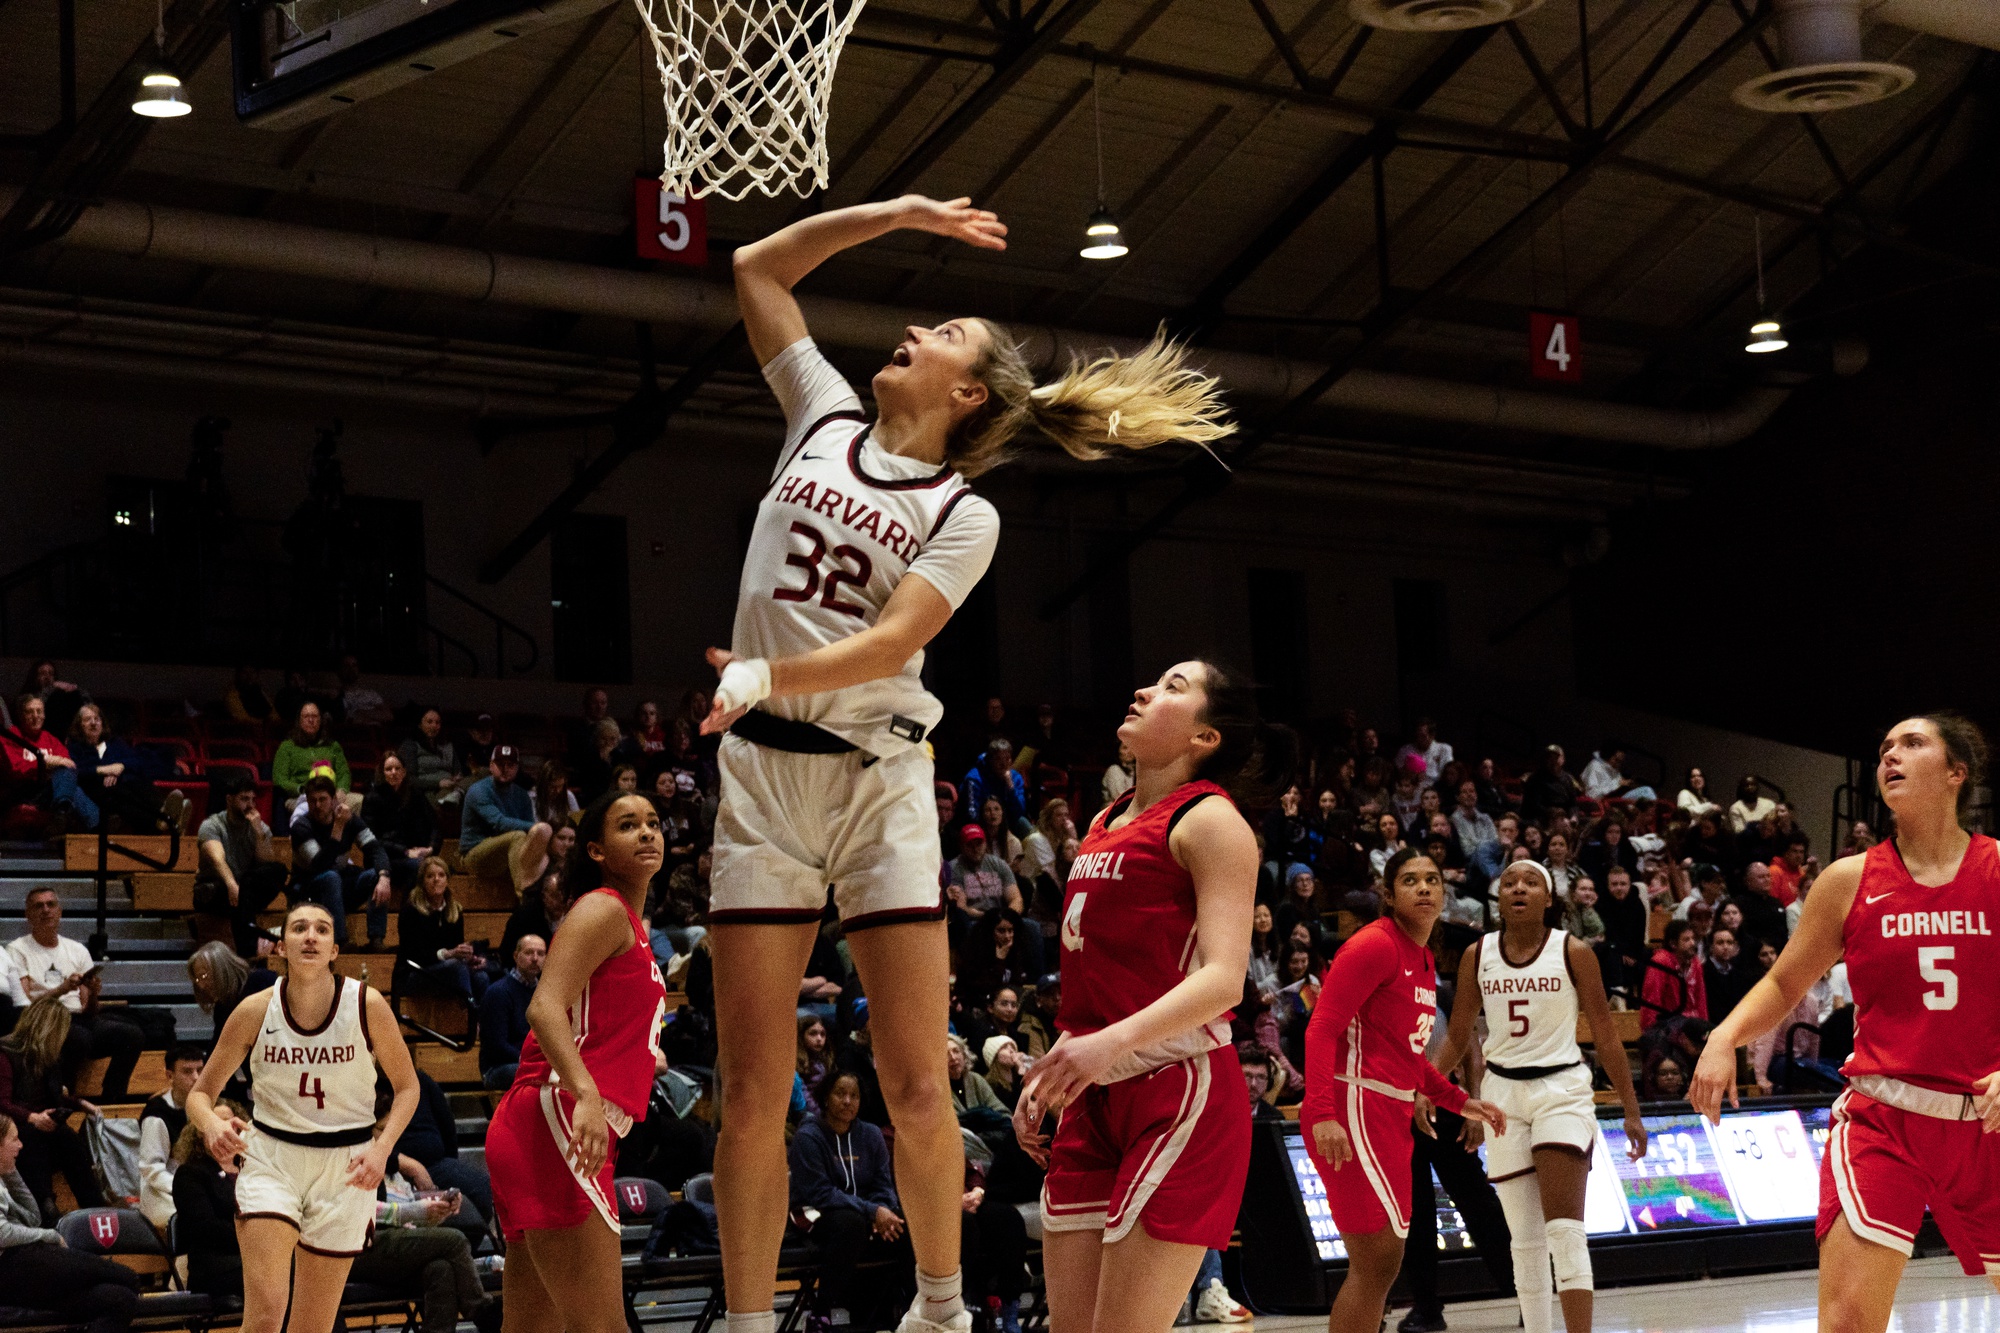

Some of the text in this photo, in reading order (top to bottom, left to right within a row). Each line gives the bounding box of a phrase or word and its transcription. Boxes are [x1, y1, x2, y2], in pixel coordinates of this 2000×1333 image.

[659, 190, 690, 251] 5
[1546, 323, 1571, 372] 4
[775, 476, 921, 566] HARVARD
[772, 520, 872, 619] 32
[1066, 851, 1125, 883] ORNELL
[1061, 892, 1088, 952] 4
[1881, 910, 1992, 938] CORNELL
[1482, 977, 1562, 995] HARVARD
[1917, 946, 1959, 1011] 5
[1508, 999, 1530, 1038] 5
[263, 1044, 355, 1065] HARVARD
[299, 1072, 326, 1110] 4
[1732, 1129, 1763, 1160] 48
[626, 1185, 643, 1206] H
[96, 1216, 113, 1238] H
